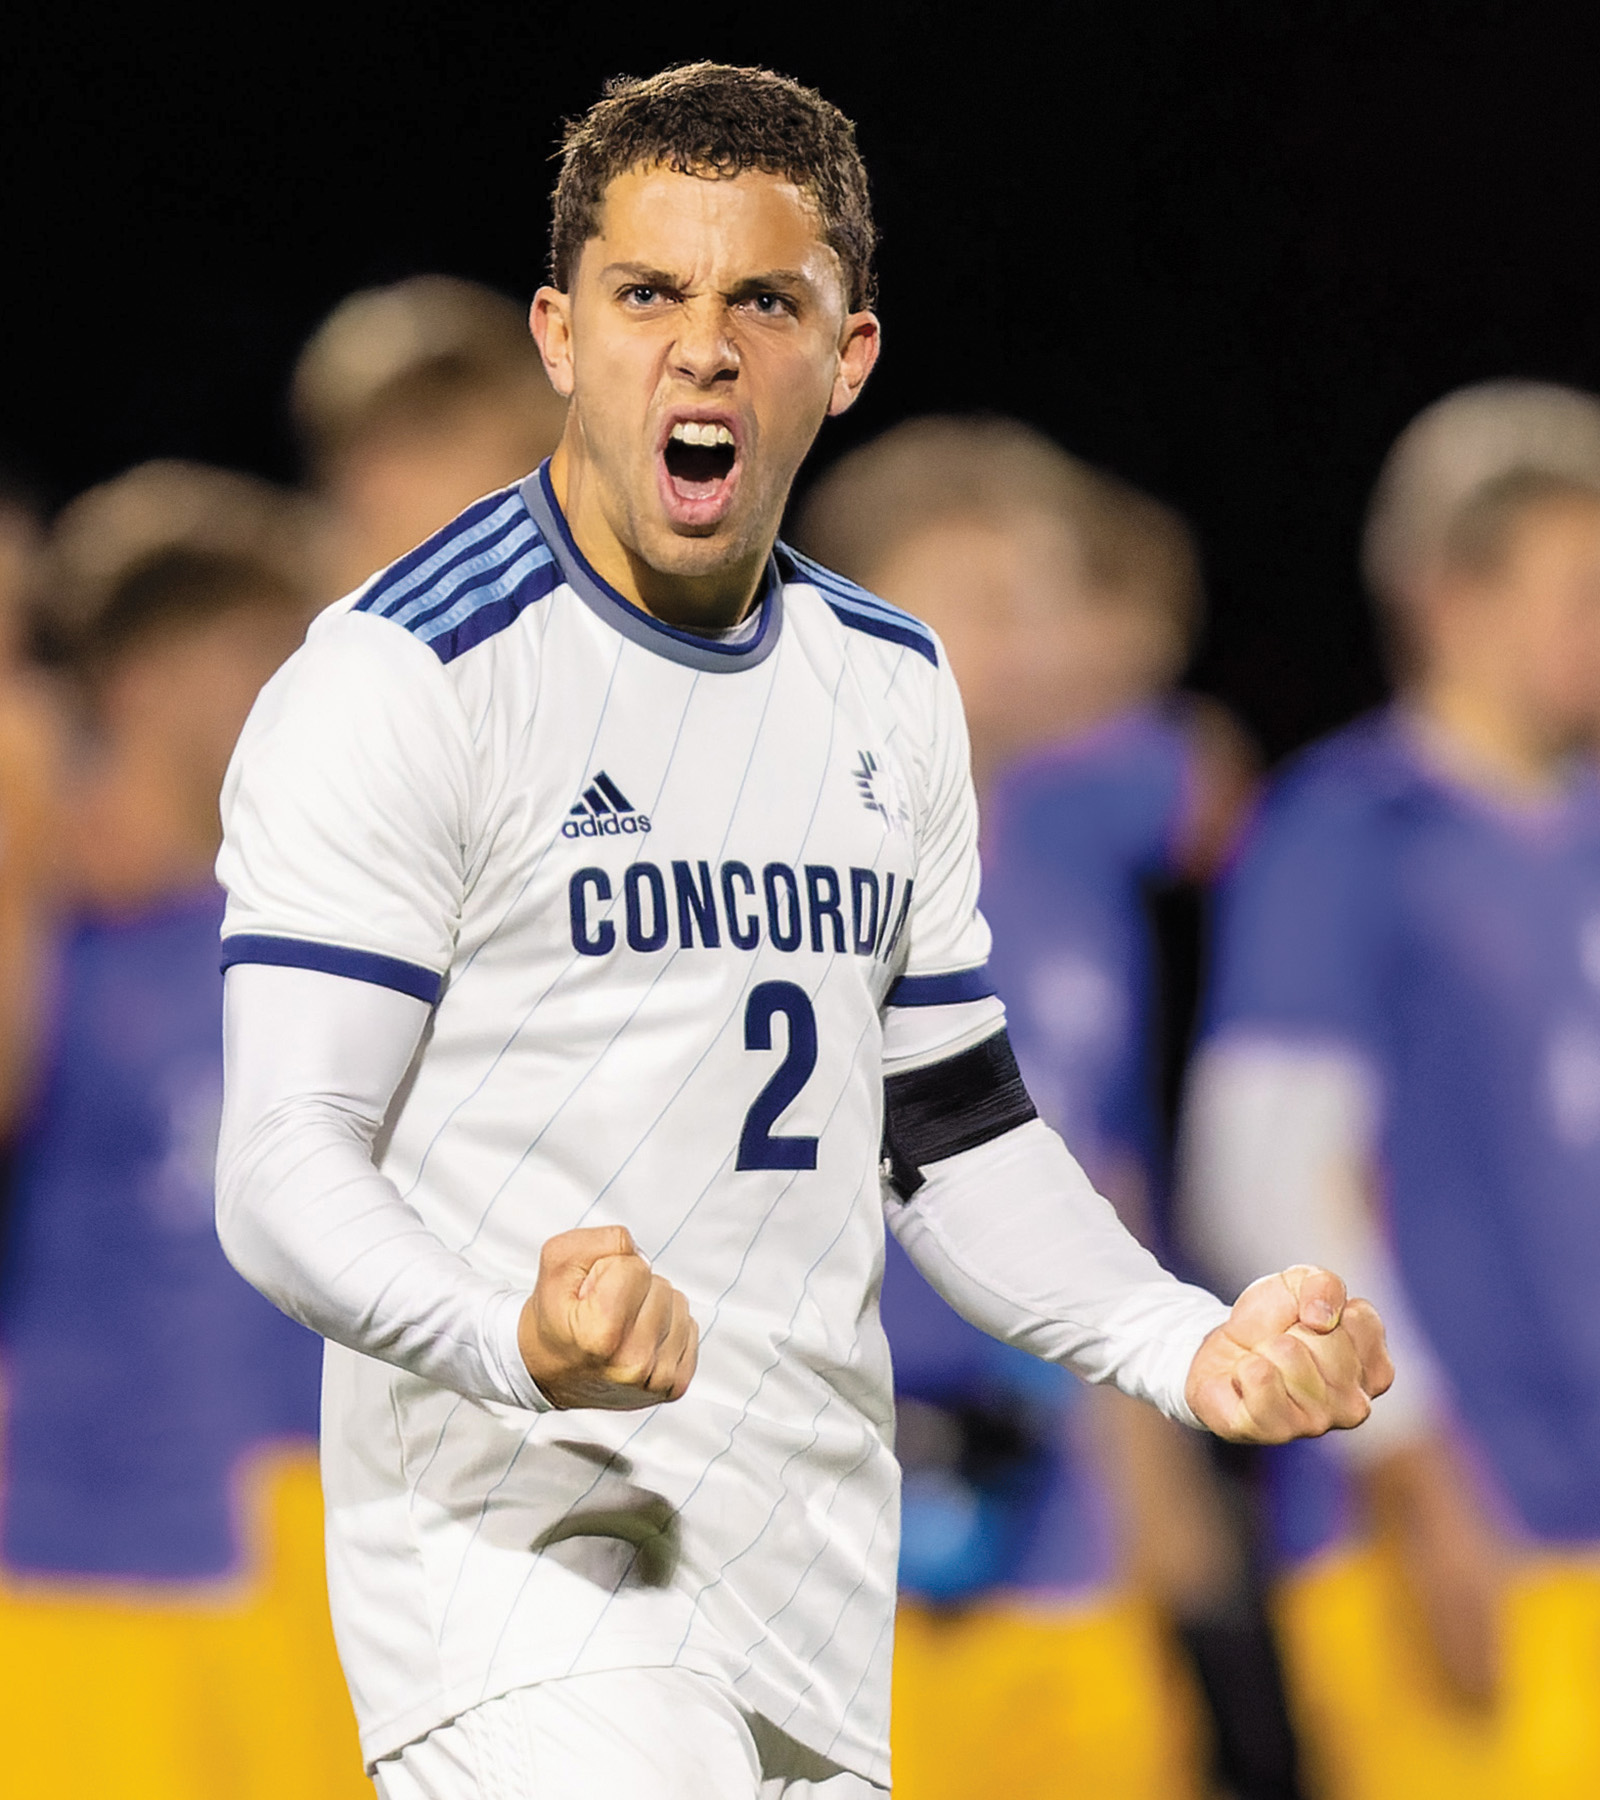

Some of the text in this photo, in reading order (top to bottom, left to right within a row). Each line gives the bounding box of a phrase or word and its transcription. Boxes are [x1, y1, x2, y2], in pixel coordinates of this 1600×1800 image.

[562, 811, 652, 839] adidas
[568, 859, 914, 964] CONCORDIA
[734, 980, 820, 1172] 2
